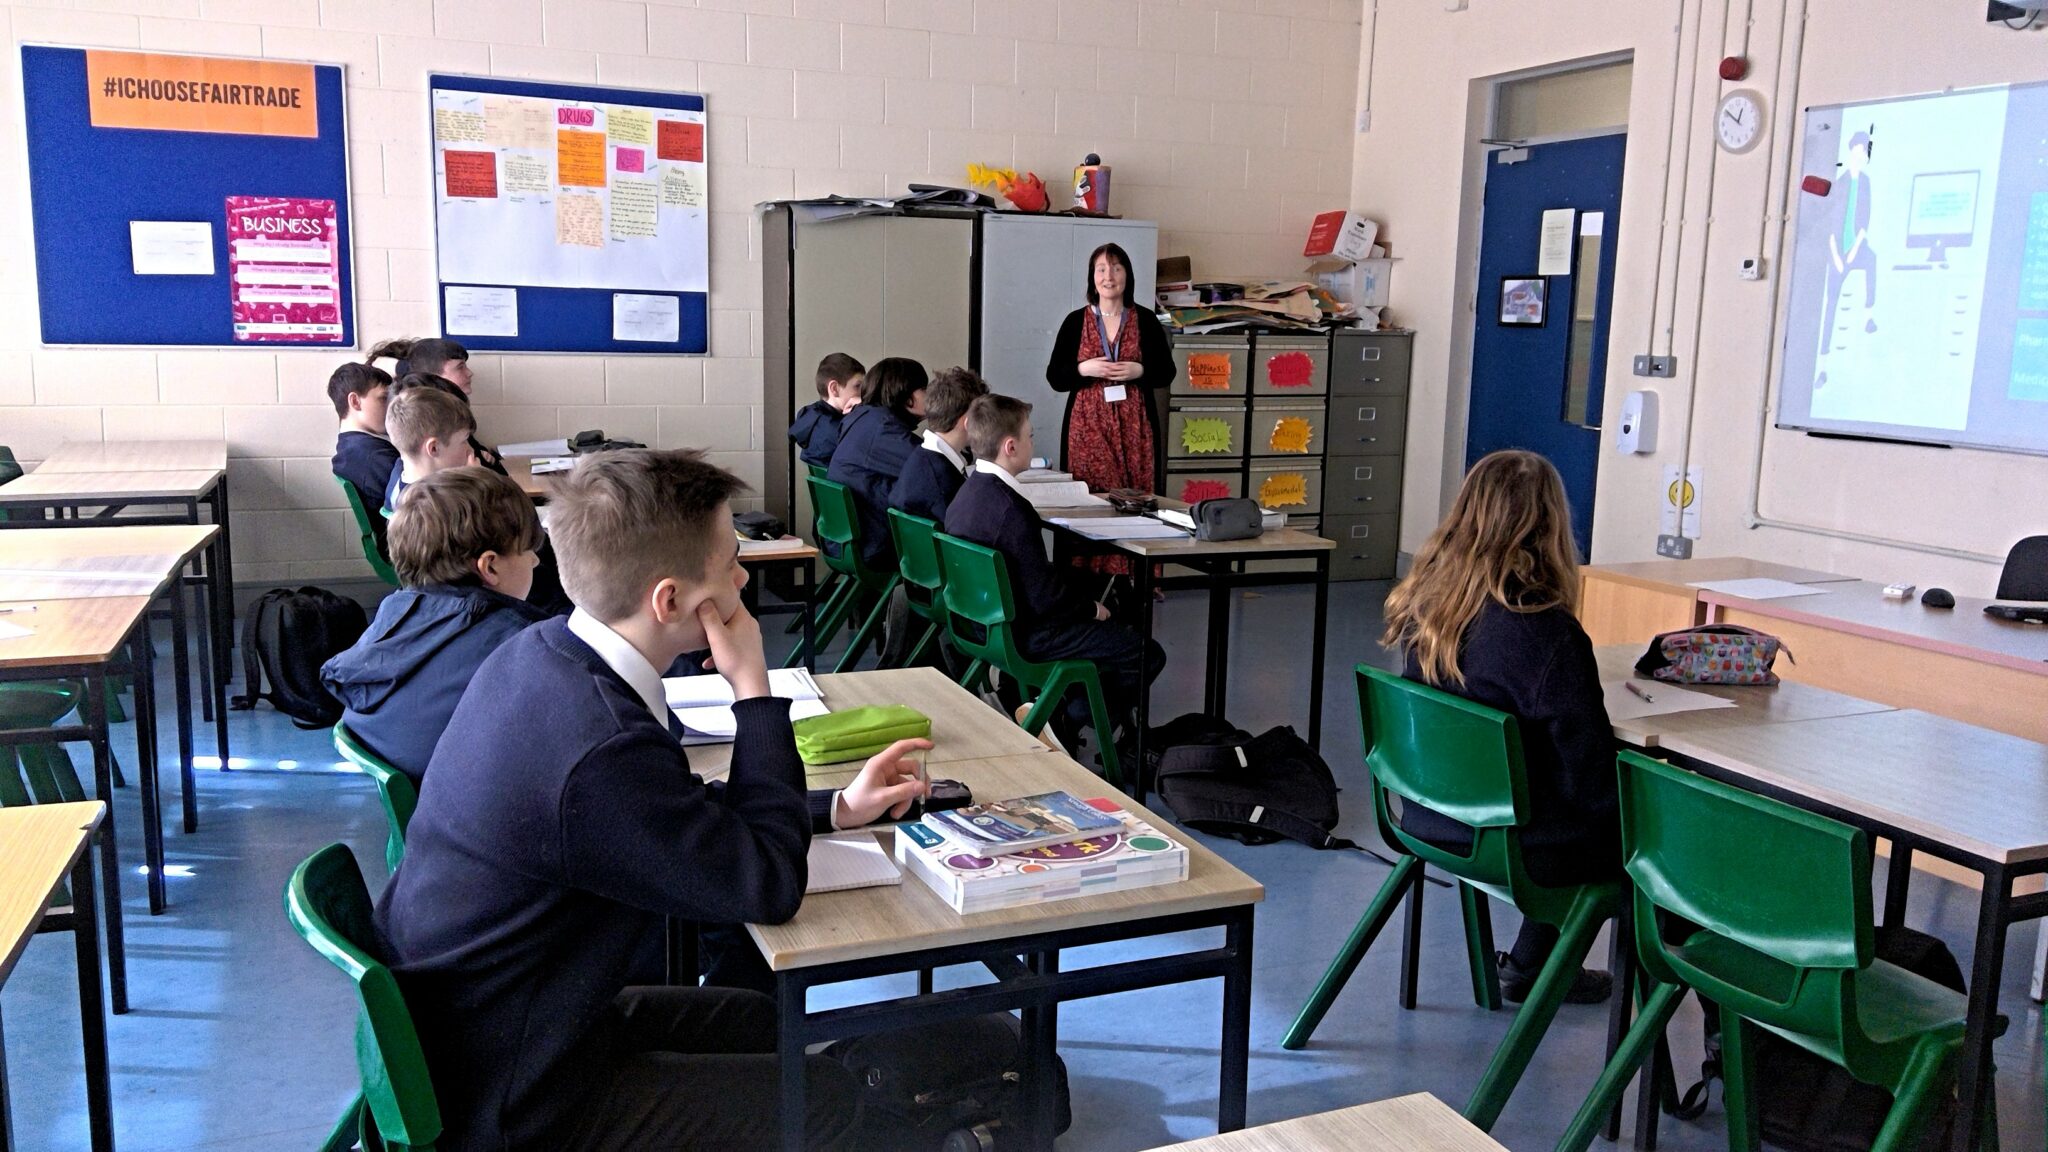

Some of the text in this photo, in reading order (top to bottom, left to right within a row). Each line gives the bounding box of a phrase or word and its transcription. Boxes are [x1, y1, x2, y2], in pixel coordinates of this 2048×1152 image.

[103, 76, 302, 109] #ICHOOSEFAIRTRADE
[558, 108, 593, 125] DRUGS
[241, 216, 322, 234] BUSINESS
